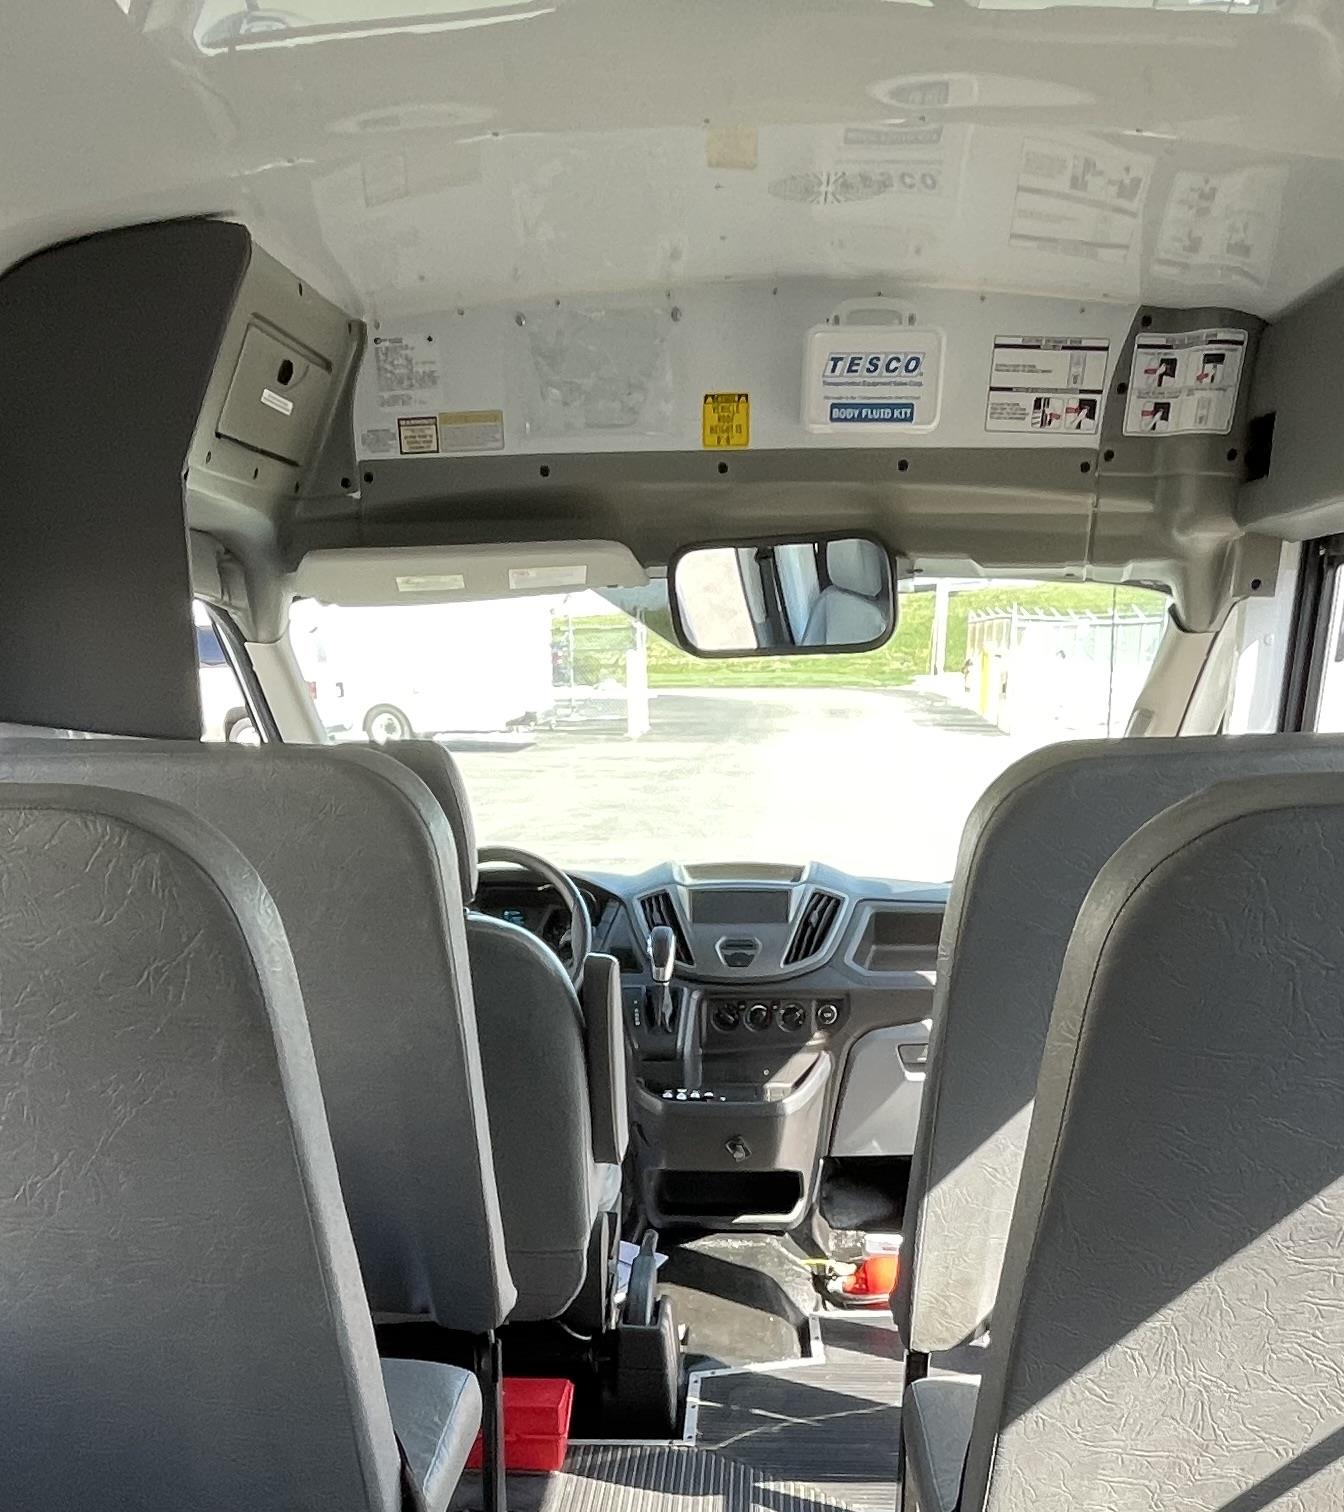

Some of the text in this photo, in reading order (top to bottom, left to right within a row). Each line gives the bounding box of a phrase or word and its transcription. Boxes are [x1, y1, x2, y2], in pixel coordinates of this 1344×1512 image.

[830, 356, 921, 374] TESCO
[832, 408, 912, 419] BODY FLUID KIT
